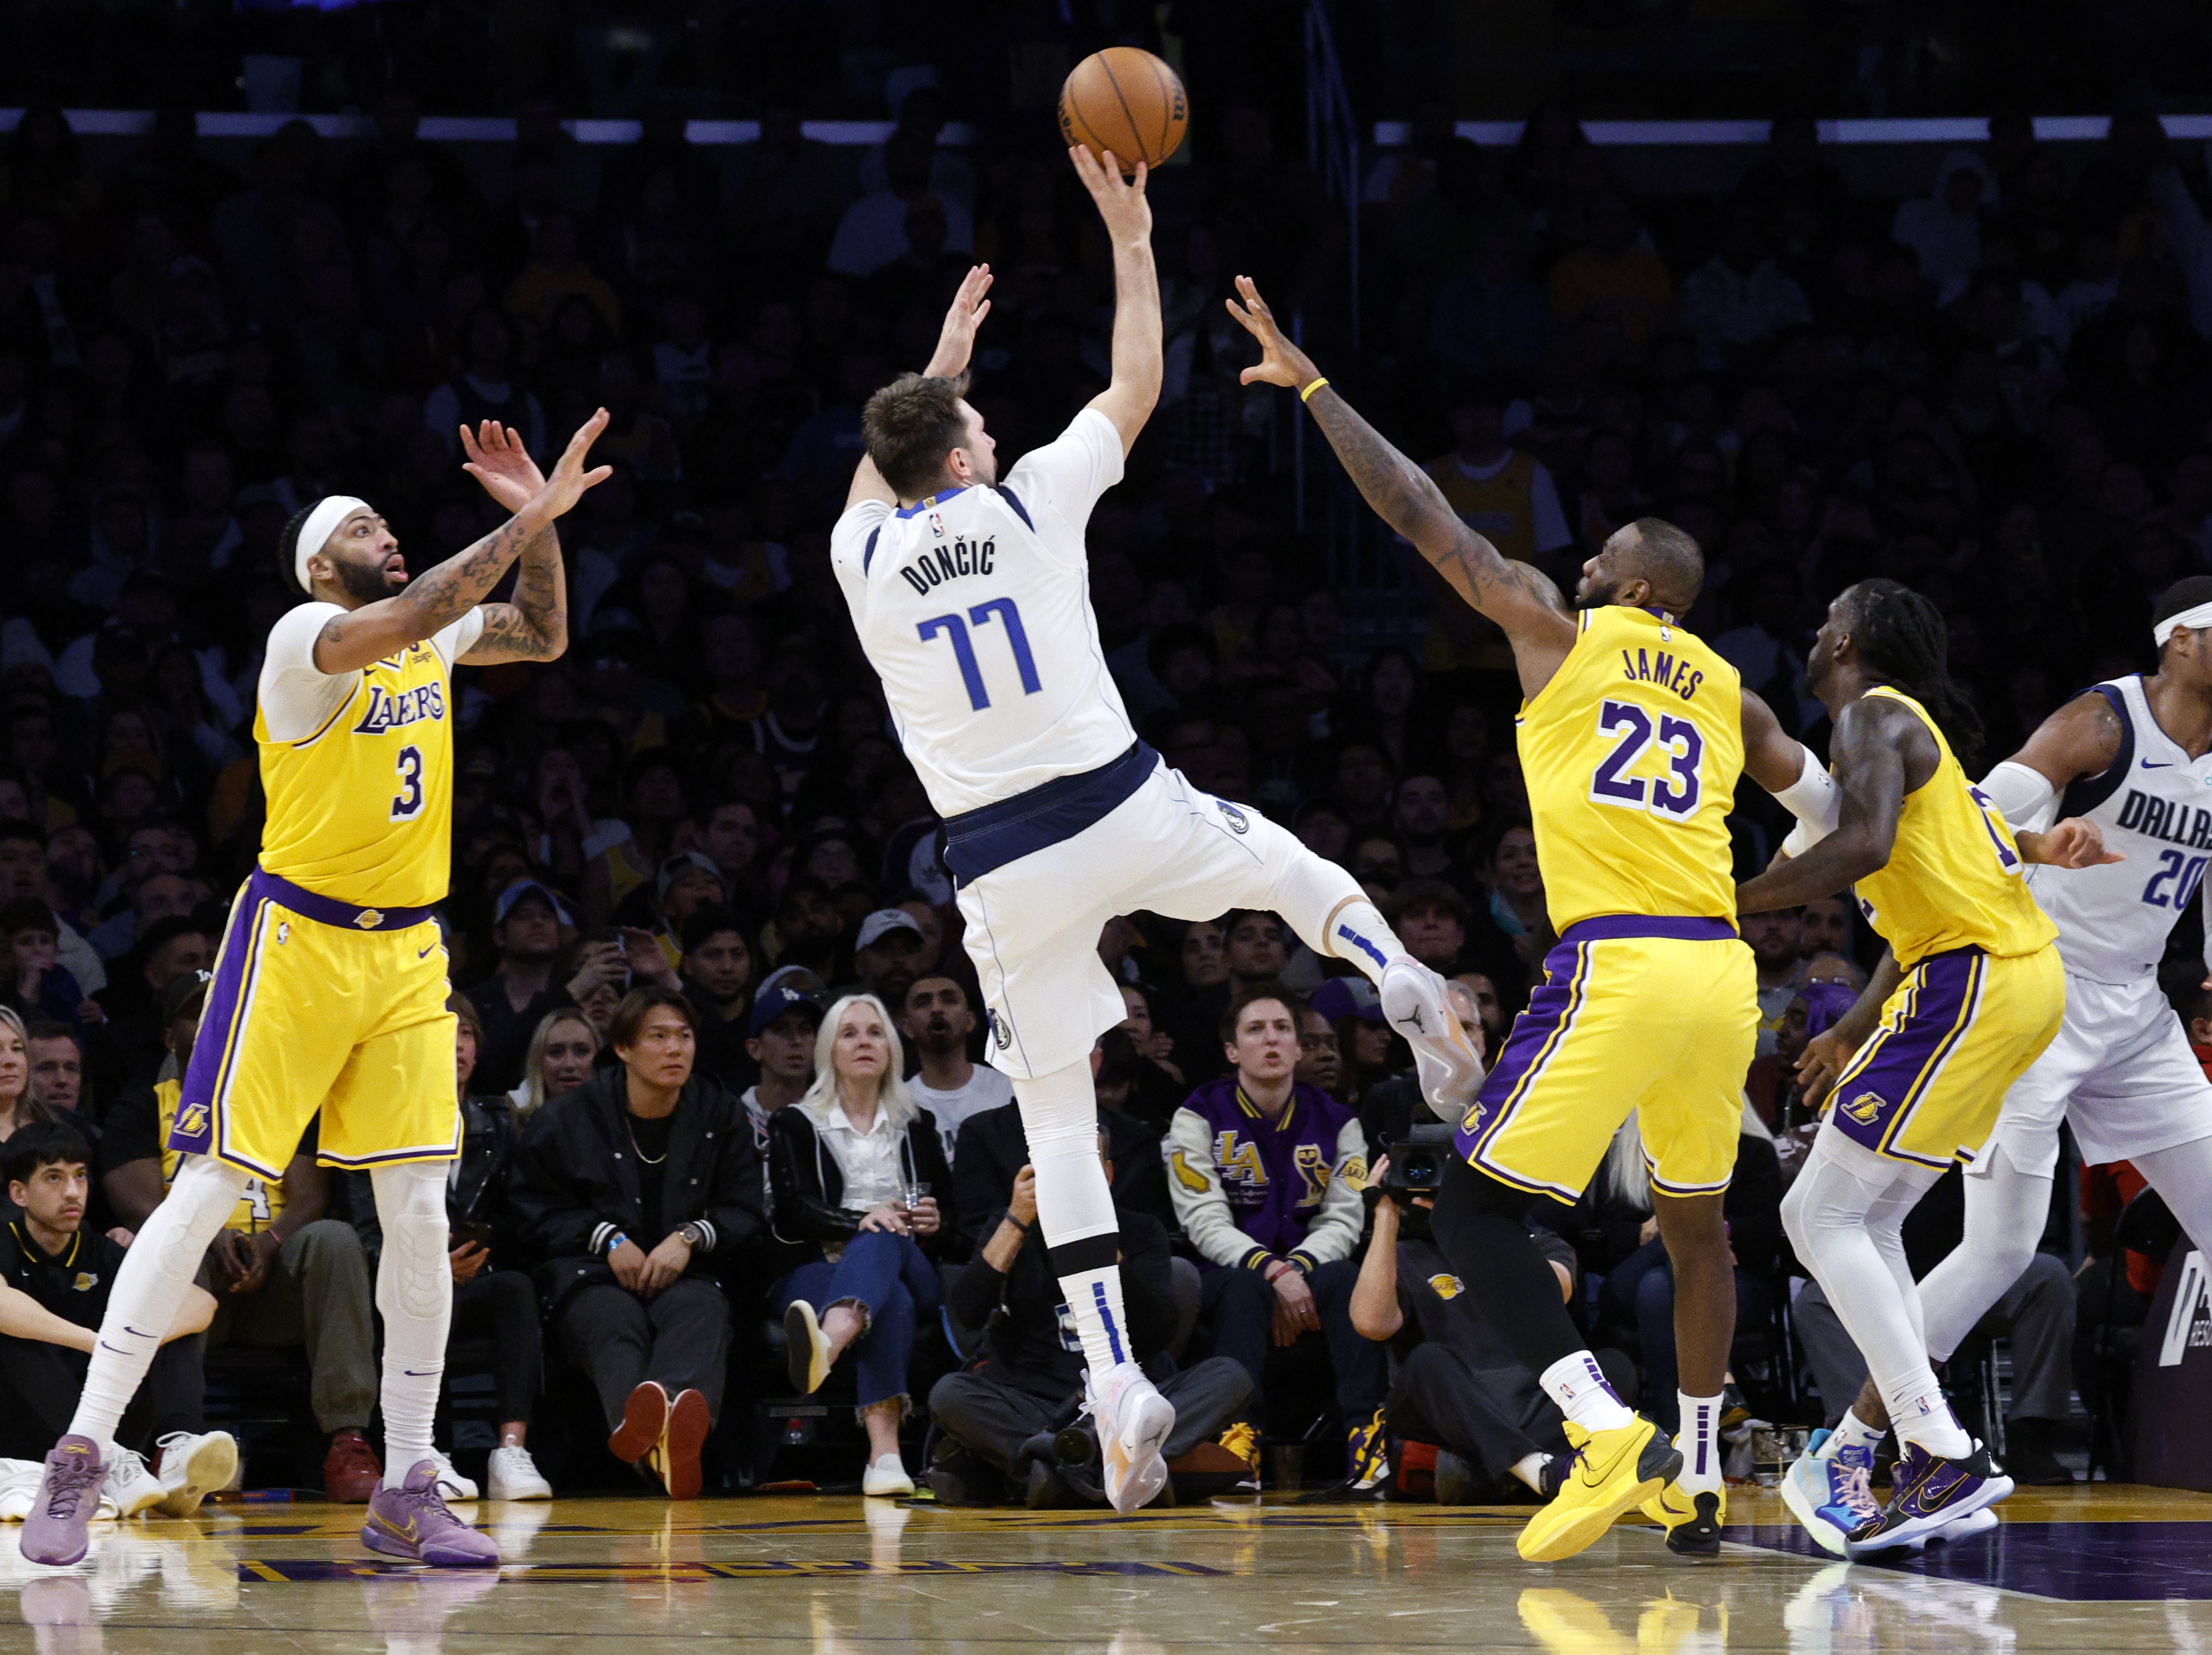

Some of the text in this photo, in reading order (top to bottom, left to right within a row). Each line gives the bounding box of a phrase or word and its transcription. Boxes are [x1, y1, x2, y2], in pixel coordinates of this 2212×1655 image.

[899, 535, 996, 596] DONČIĆ
[916, 596, 1043, 712] 77
[1622, 648, 1704, 700] JAMES
[389, 744, 426, 822] 3
[1589, 698, 1706, 823] 23
[2142, 848, 2208, 912] 20
[1213, 1130, 1269, 1186] LA
